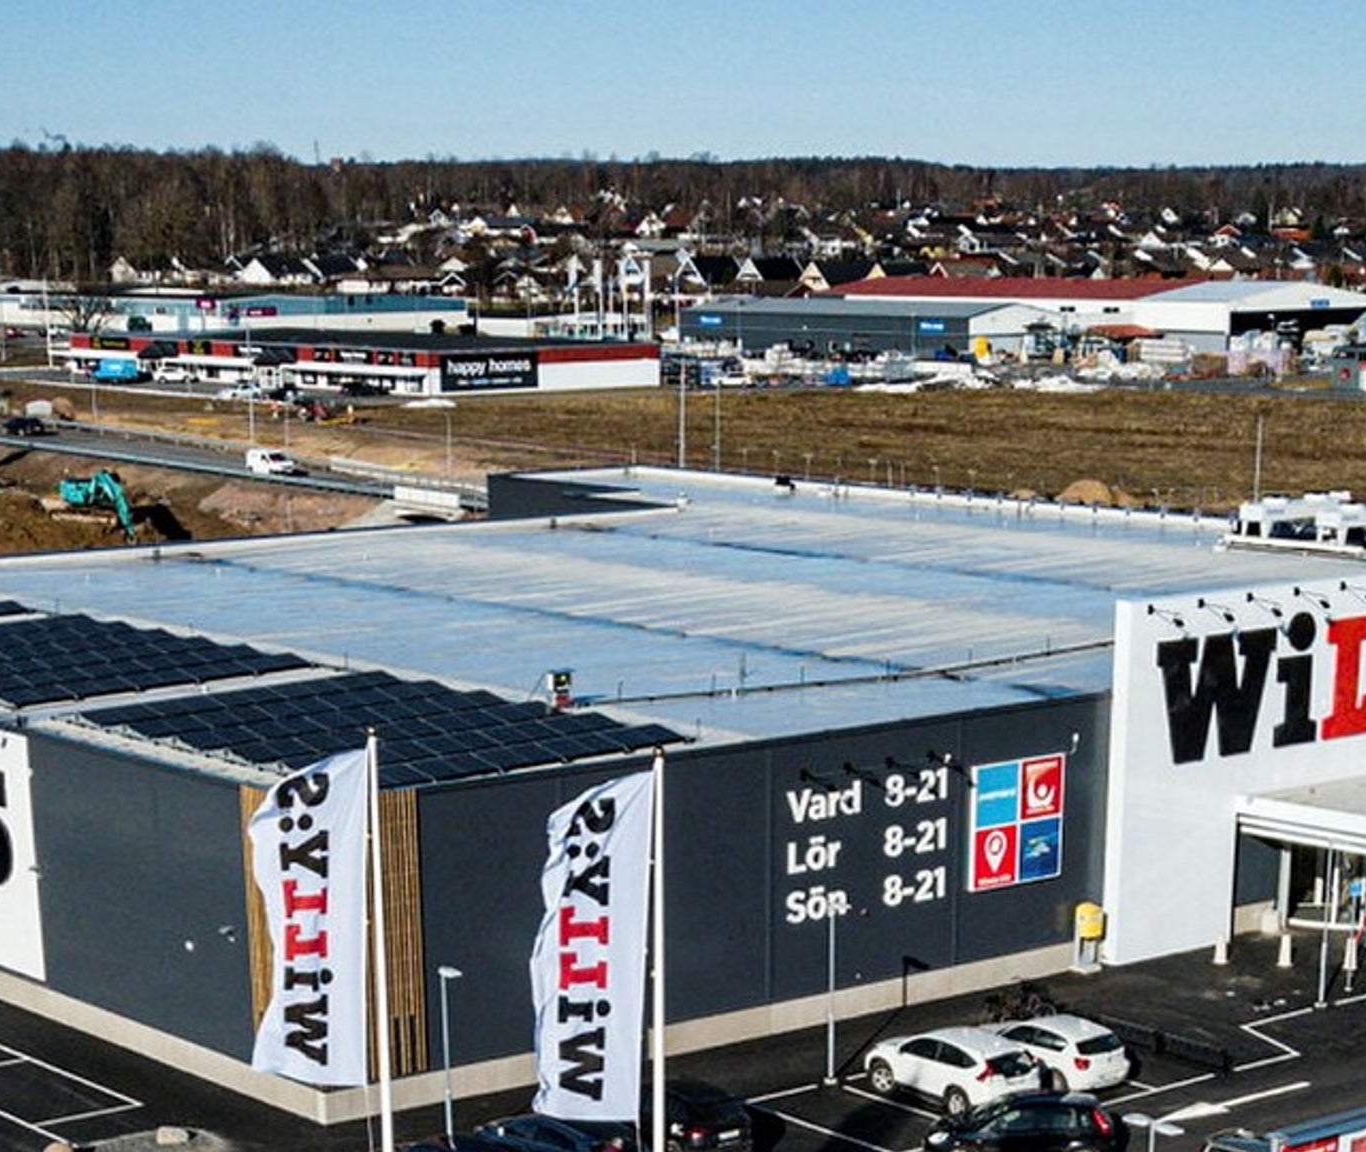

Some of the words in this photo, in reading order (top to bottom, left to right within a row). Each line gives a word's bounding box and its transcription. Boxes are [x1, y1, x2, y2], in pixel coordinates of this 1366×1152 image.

[447, 359, 487, 376] happy
[488, 357, 531, 374] homes
[786, 779, 862, 824] Vard
[884, 766, 949, 807] 8-21
[786, 835, 842, 875] Lör
[883, 816, 947, 858] 8-21
[786, 885, 848, 924] Sön
[883, 865, 946, 907] 8-21
